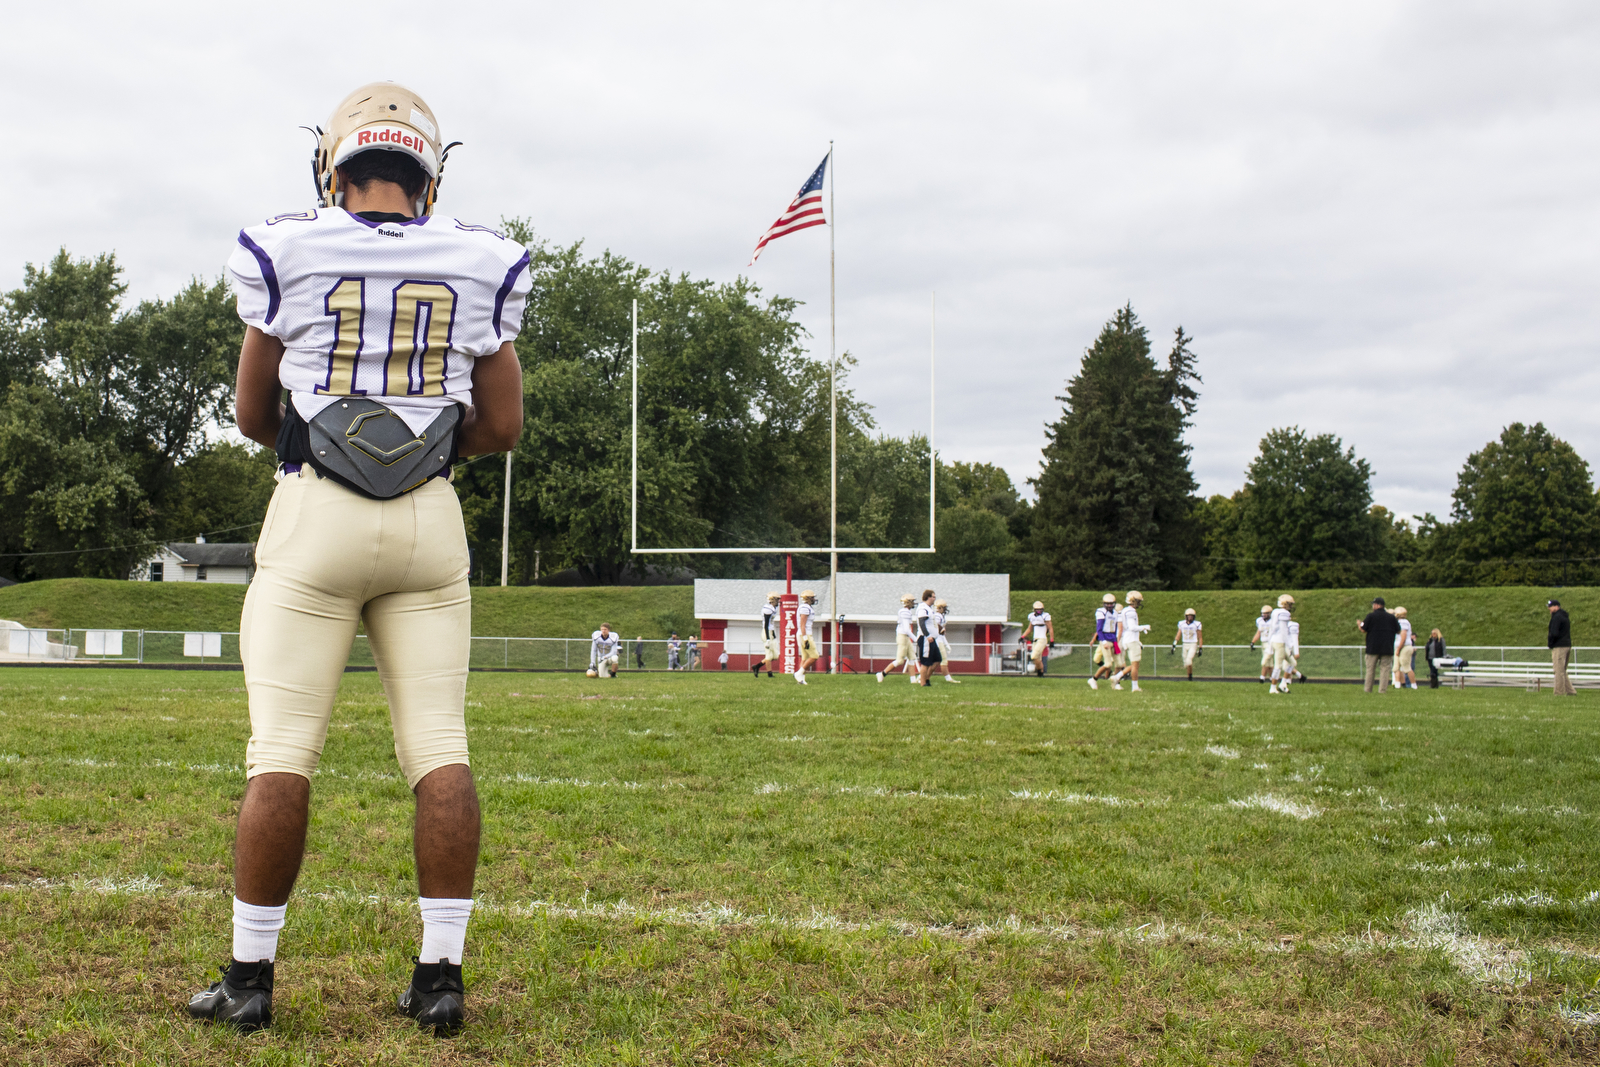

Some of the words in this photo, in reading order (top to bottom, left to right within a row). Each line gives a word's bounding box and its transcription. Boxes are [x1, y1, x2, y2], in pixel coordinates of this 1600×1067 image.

[358, 129, 424, 154] Riddell
[378, 228, 404, 238] Riddell
[313, 276, 458, 396] 10
[784, 610, 796, 674] FALCONS
